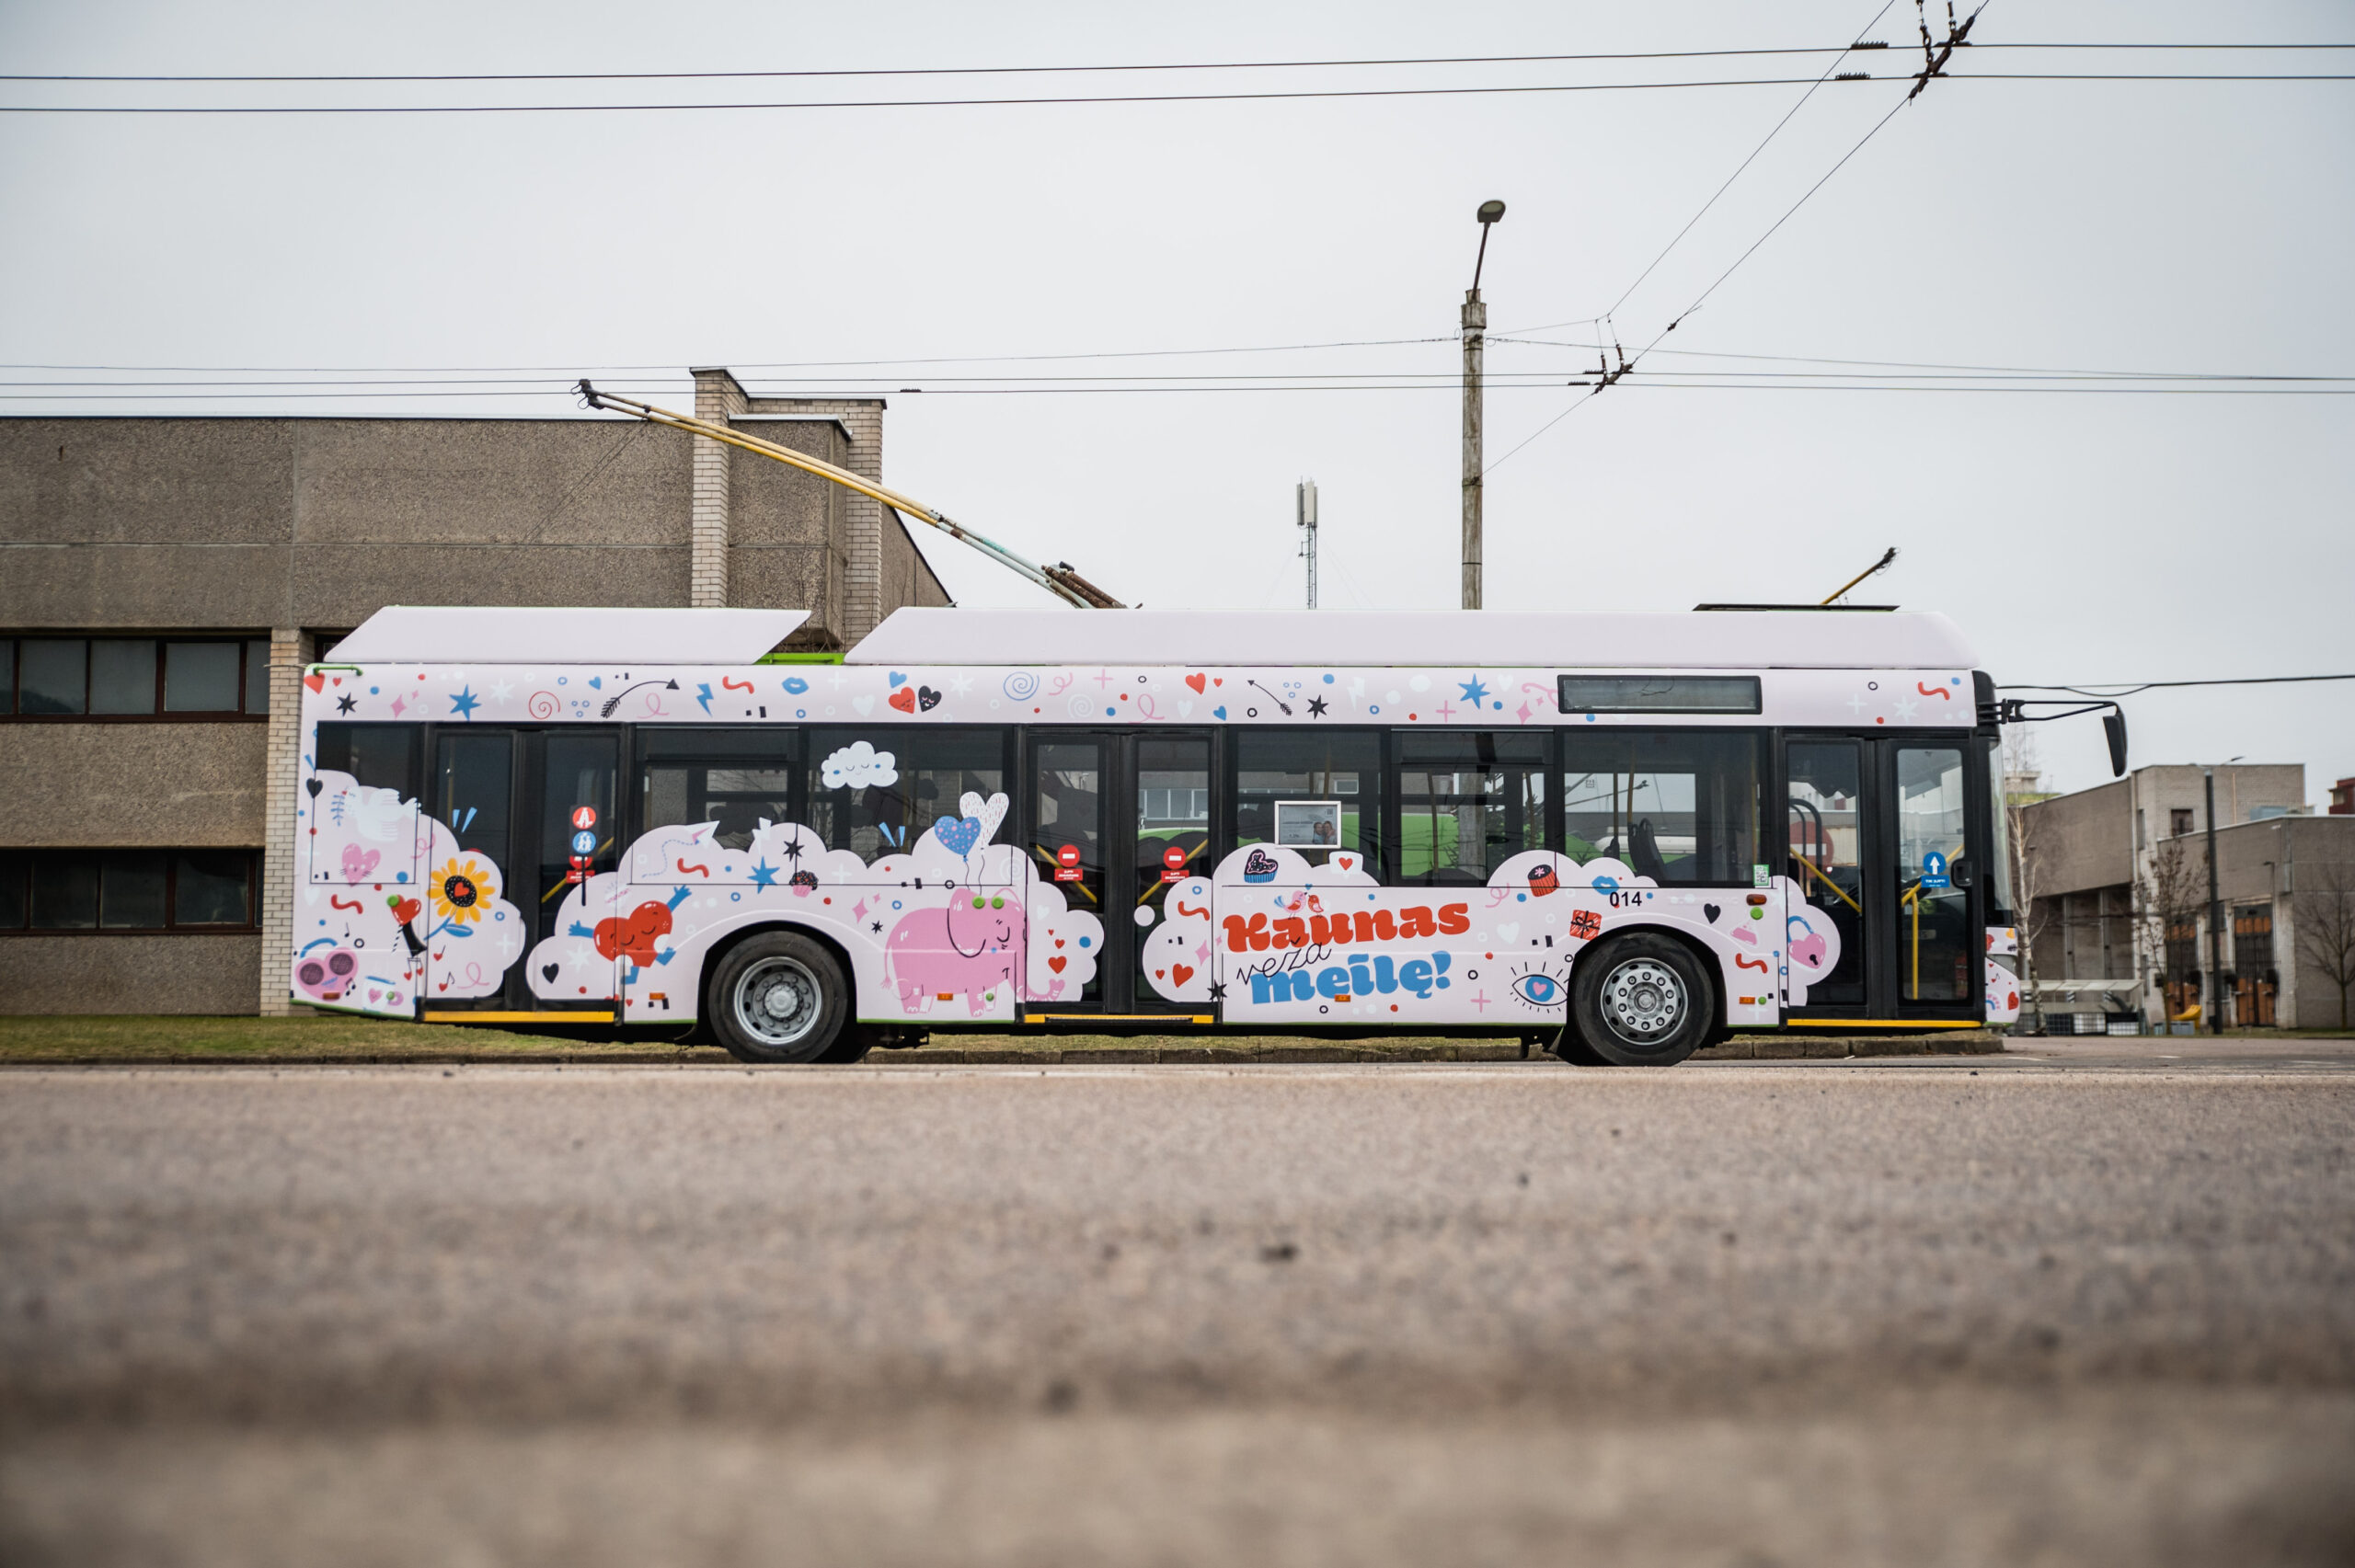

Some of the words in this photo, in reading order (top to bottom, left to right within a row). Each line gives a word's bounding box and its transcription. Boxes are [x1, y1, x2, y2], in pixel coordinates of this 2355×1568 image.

[1610, 891, 1642, 907] 014
[1223, 902, 1471, 953] Kaunas
[1236, 936, 1332, 985] veža
[1250, 950, 1453, 1005] meilę!
